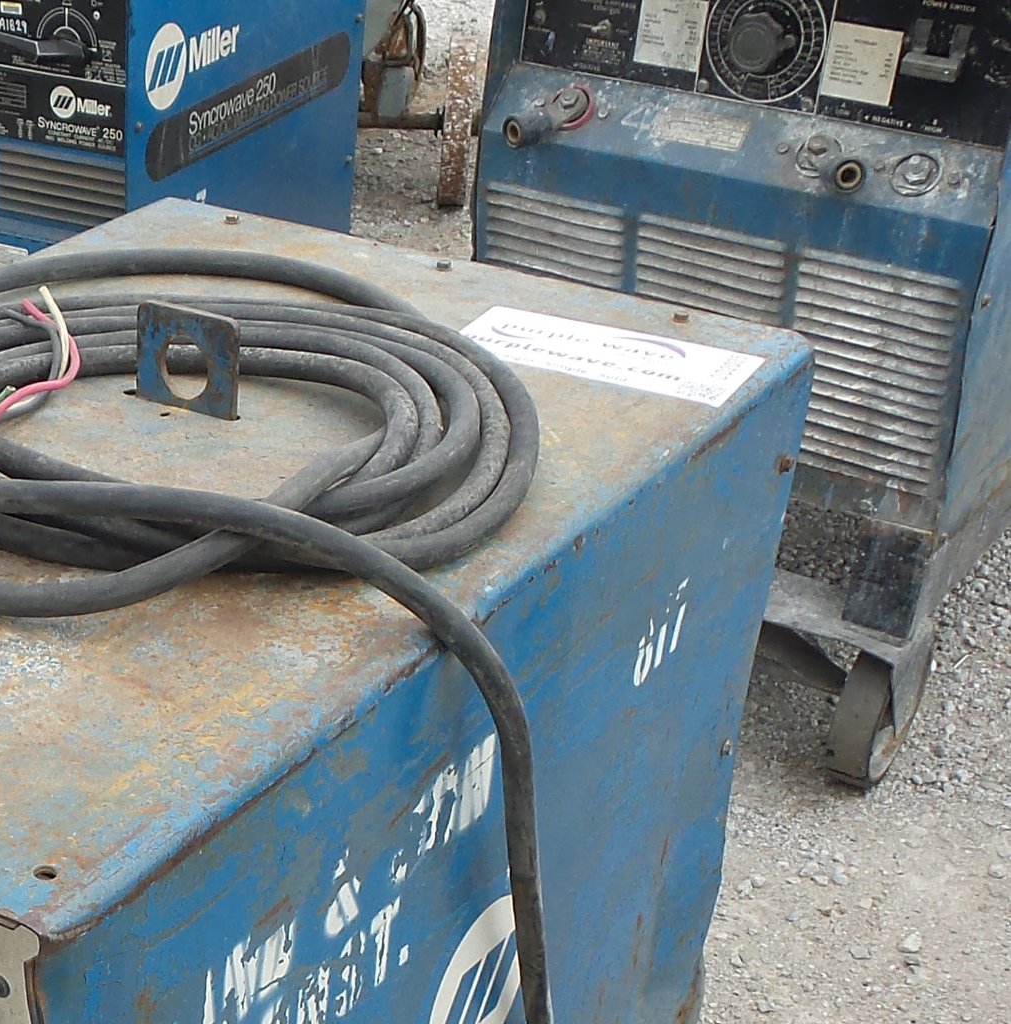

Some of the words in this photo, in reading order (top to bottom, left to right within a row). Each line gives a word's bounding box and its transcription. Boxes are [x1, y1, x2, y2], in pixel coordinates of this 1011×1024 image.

[188, 24, 240, 73] Miller
[77, 97, 110, 117] Miller
[189, 87, 254, 136] Syncrowave
[255, 72, 277, 100] 250
[37, 116, 97, 138] SYNCROWAVE
[103, 127, 123, 141] 250
[501, 322, 590, 345] purple
[602, 341, 675, 360] wave
